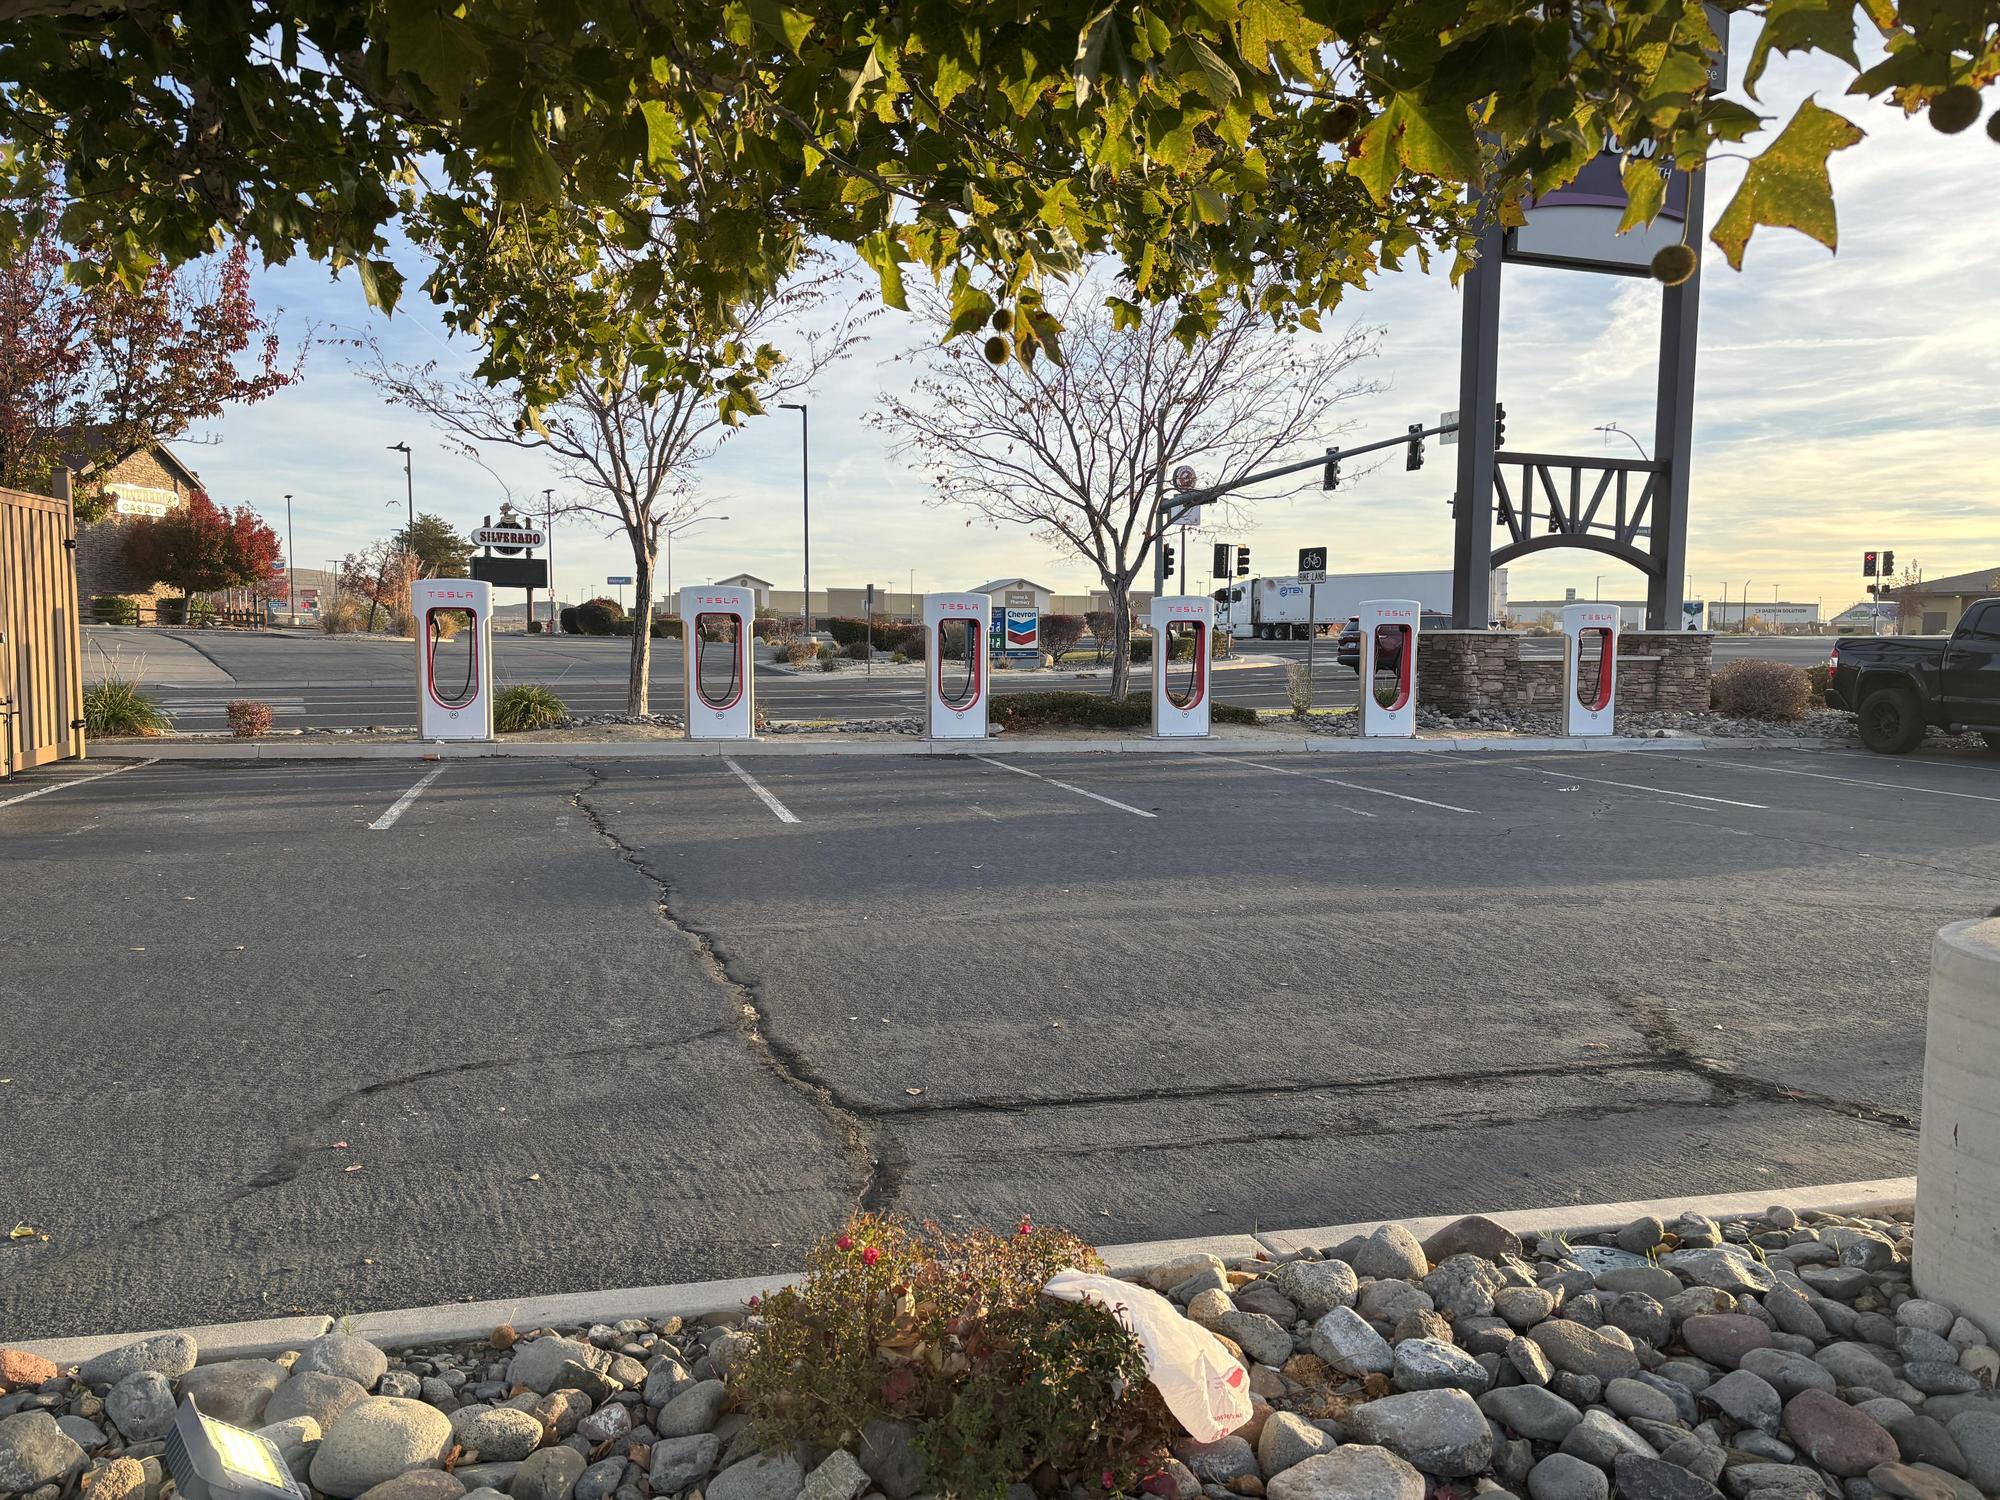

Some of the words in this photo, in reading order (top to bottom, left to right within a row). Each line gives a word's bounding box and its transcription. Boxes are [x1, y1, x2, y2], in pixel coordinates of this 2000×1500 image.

[122, 503, 163, 515] CASINO
[479, 531, 541, 545] SILVERADO
[1299, 572, 1310, 582] BIKE
[1311, 571, 1325, 581] LANE
[427, 591, 473, 599] TESLA
[1007, 610, 1037, 618] Chevron
